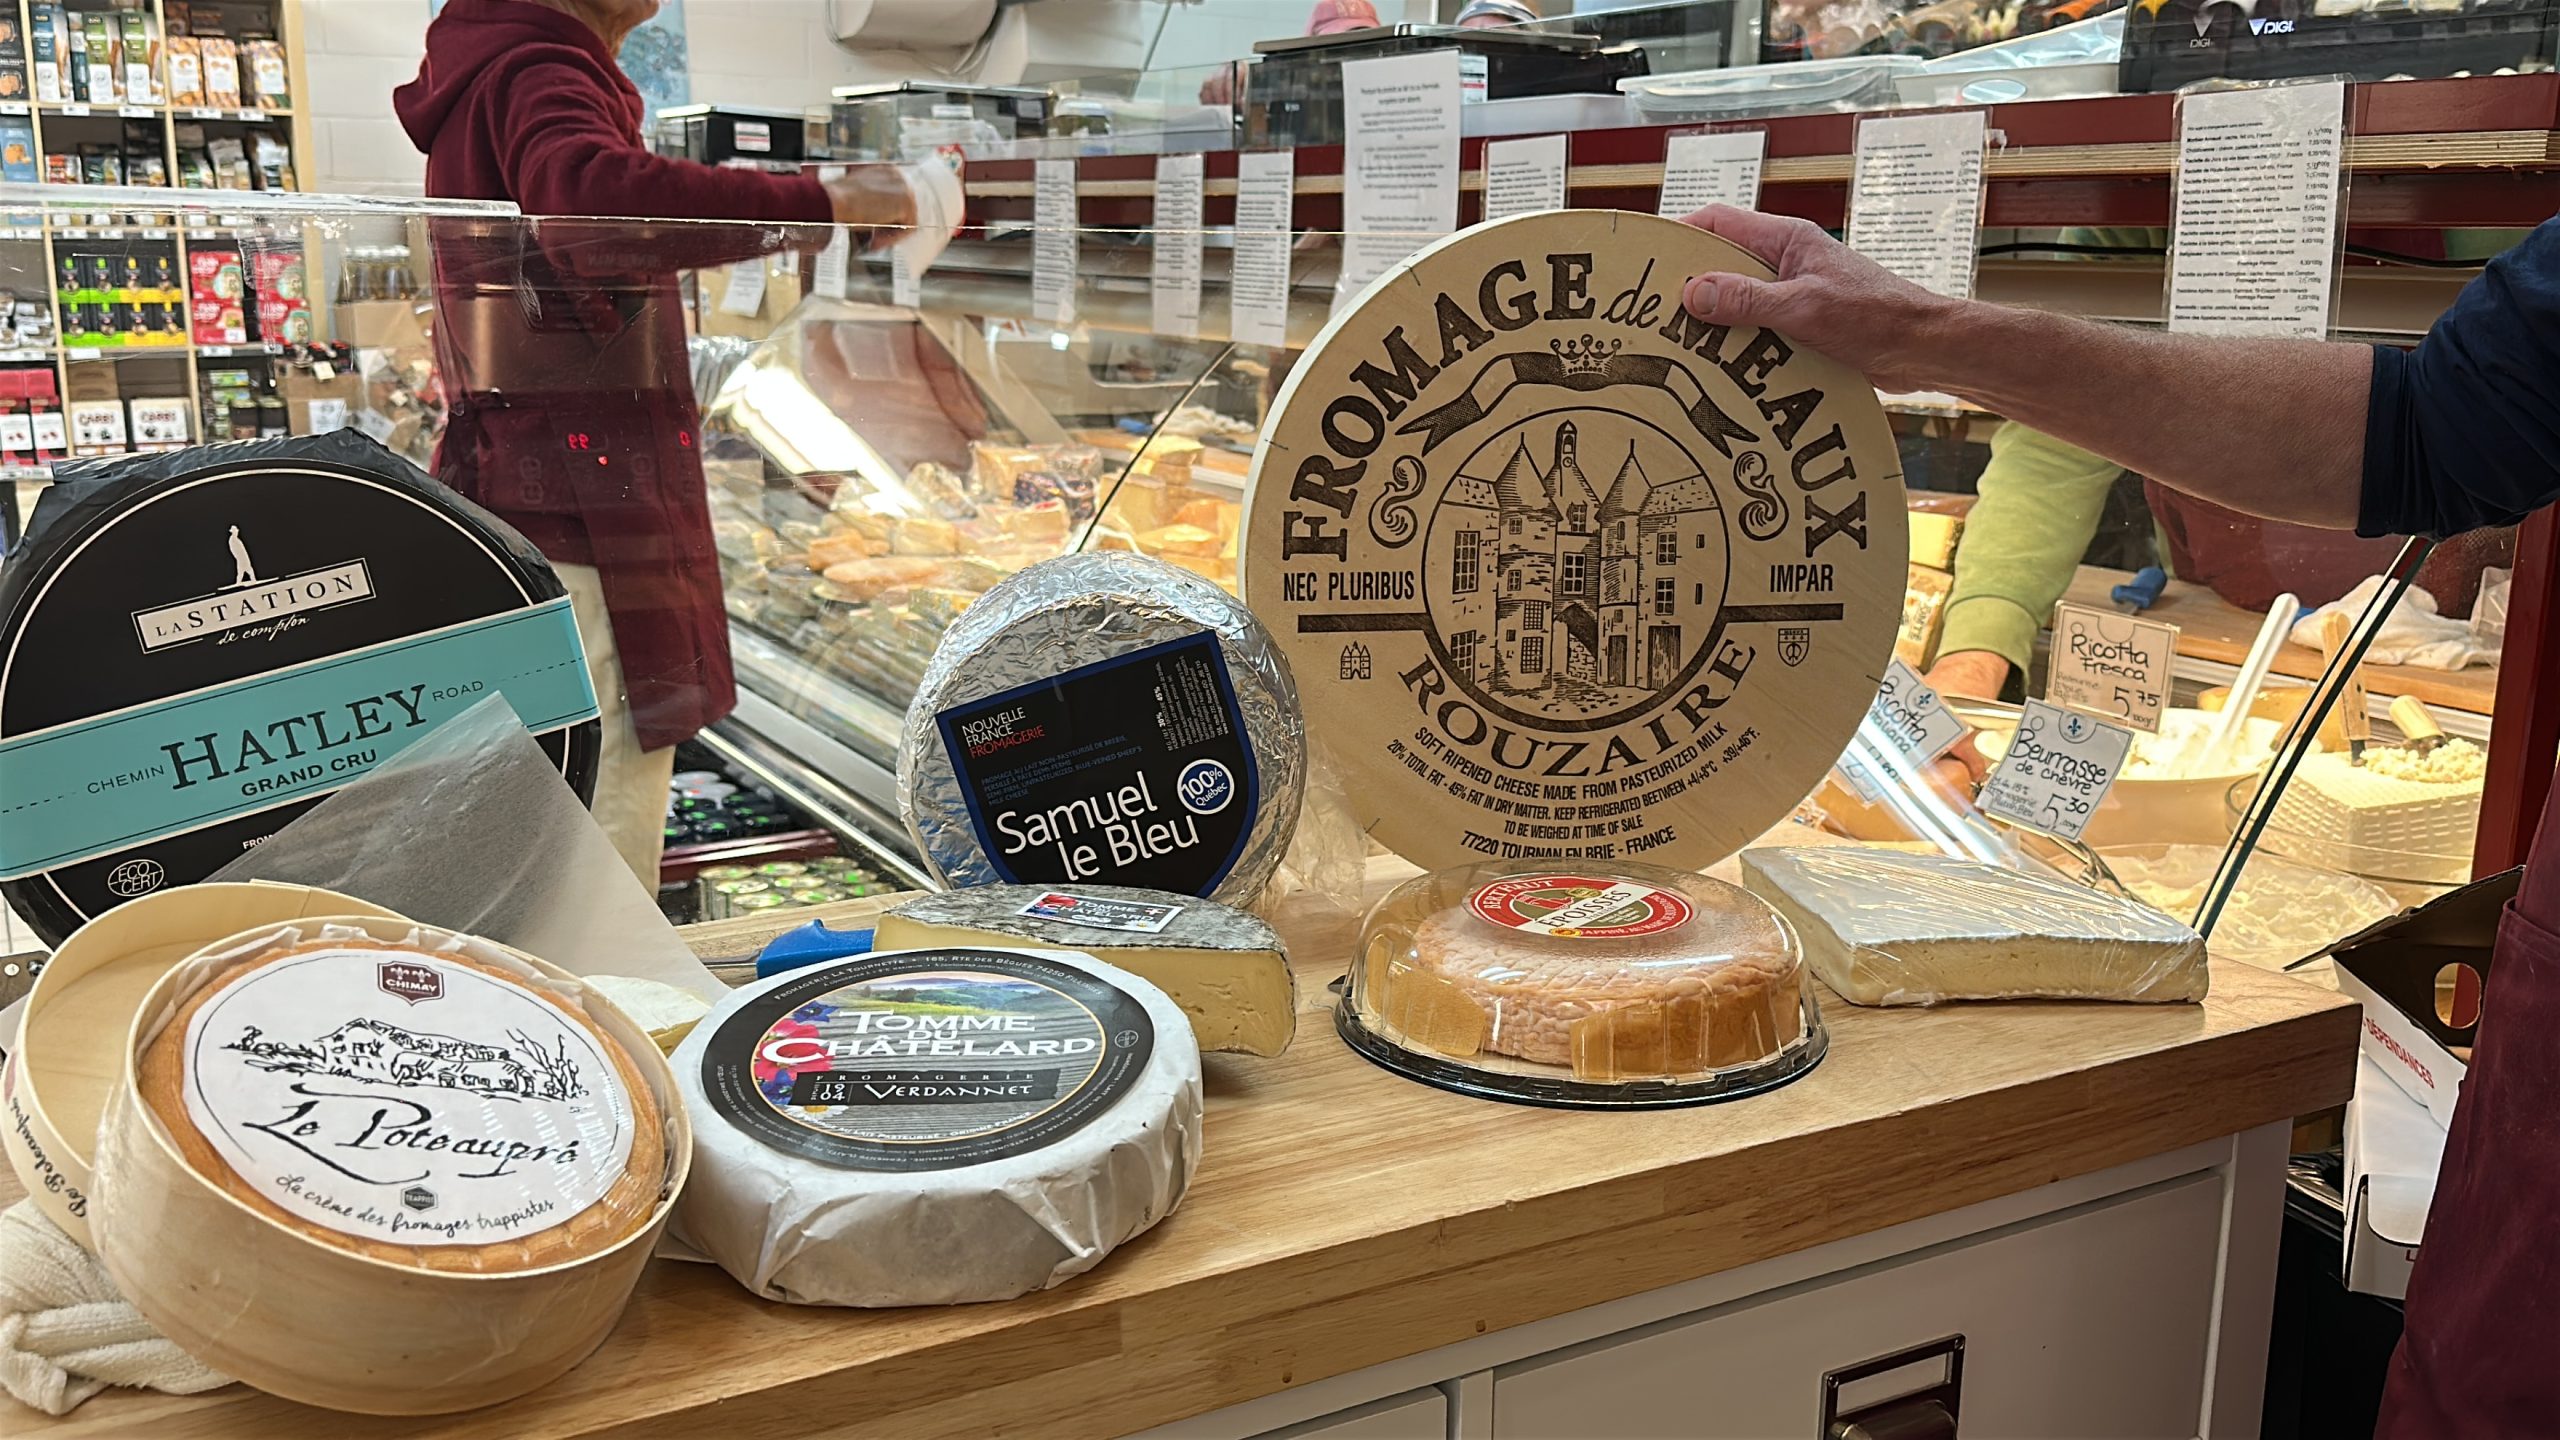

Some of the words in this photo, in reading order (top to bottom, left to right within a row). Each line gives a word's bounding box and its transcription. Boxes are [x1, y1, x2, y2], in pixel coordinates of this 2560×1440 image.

[1281, 251, 1600, 563] FROMAGE
[1601, 257, 1664, 329] de
[1658, 277, 1869, 558] MEAUX
[1282, 572, 1319, 603] NEC
[1328, 569, 1415, 601] PLURIBUS
[1769, 563, 1835, 594] IMPAR
[155, 621, 183, 637] LA
[187, 573, 354, 628] STATION
[215, 630, 239, 646] de
[2070, 633, 2149, 669] Ricotta
[2079, 656, 2148, 684] Fresca
[1153, 686, 1164, 702] 45%
[1398, 638, 1757, 777] ROUZAIRE
[961, 706, 1027, 737] NOUVELLE
[965, 722, 1014, 748] FRANCE
[1155, 711, 1166, 728] 30%
[86, 763, 165, 795] CHEMIN
[160, 683, 427, 790] HATLEY
[431, 680, 485, 703] ROAD
[969, 724, 1046, 760] FROMAGERIE
[240, 763, 324, 799] GRAND
[329, 748, 378, 773] CRU
[1414, 726, 1446, 757] SOFT
[1441, 750, 1493, 785] RIPENED
[1493, 774, 1541, 799] CHEESE
[1543, 784, 1577, 801] MADE
[1582, 779, 1618, 800] FROM
[1620, 745, 1699, 793] PASTEURIZED
[1696, 721, 1729, 755] MILK
[1181, 764, 1224, 801] 100%
[1386, 738, 1405, 760] 20%
[1403, 751, 1430, 777] TOTAL
[1426, 767, 1446, 788] FAT
[1448, 780, 1468, 800] 45%
[1466, 789, 1484, 805] FAT
[1483, 794, 1495, 811] IN
[1494, 798, 1516, 816] DRY
[1513, 803, 1551, 821] MATTER.
[1554, 806, 1576, 821] KEEP
[1578, 796, 1642, 820] REFRIGERATED
[1642, 778, 1688, 808] BEETWEEN
[2015, 759, 2034, 776] de
[2040, 766, 2092, 796] chèvre
[1193, 780, 1229, 807] Québec
[996, 770, 1159, 855] Samuel
[1504, 819, 1515, 835] TO
[1516, 821, 1530, 838] BE
[1530, 823, 1570, 840] WEIGHED
[1571, 825, 1584, 840] AT
[1584, 822, 1606, 839] TIME
[1607, 819, 1620, 836] OF
[1621, 814, 1645, 832] SALE
[1057, 840, 1100, 882] le
[1105, 814, 1201, 869] Bleu
[1460, 829, 1500, 856] 77220
[1585, 843, 1616, 860] BRIE
[1625, 825, 1677, 855] FRANCE
[117, 861, 151, 883] ECO
[120, 873, 160, 896] CERT
[1075, 900, 1138, 913] TOMME
[1483, 879, 1555, 909] BERTHAUT
[1535, 889, 1633, 929] ÉPOISSES
[385, 978, 438, 992] CHIMAY
[772, 974, 830, 1000] FROMAGERIE
[845, 959, 905, 973] TOURNETTE
[838, 1009, 1036, 1034] TOMME
[907, 1030, 959, 1040] DU
[762, 1034, 1096, 1064] CHÂTELARD
[815, 1073, 1034, 1082] FROMAGERIE
[864, 1084, 1033, 1099] VERDANNET
[289, 1082, 580, 1179] Poteaupré
[877, 1131, 940, 1140] PASTEURISÉ
[949, 1124, 992, 1138] ORIGINE
[994, 1111, 1033, 1129] FRANCE
[64, 1187, 88, 1218] Le
[276, 1173, 305, 1196] La
[304, 1188, 354, 1219] crème
[356, 1203, 388, 1228] des
[391, 1210, 472, 1239] fromages
[478, 1198, 555, 1231] trappistes
